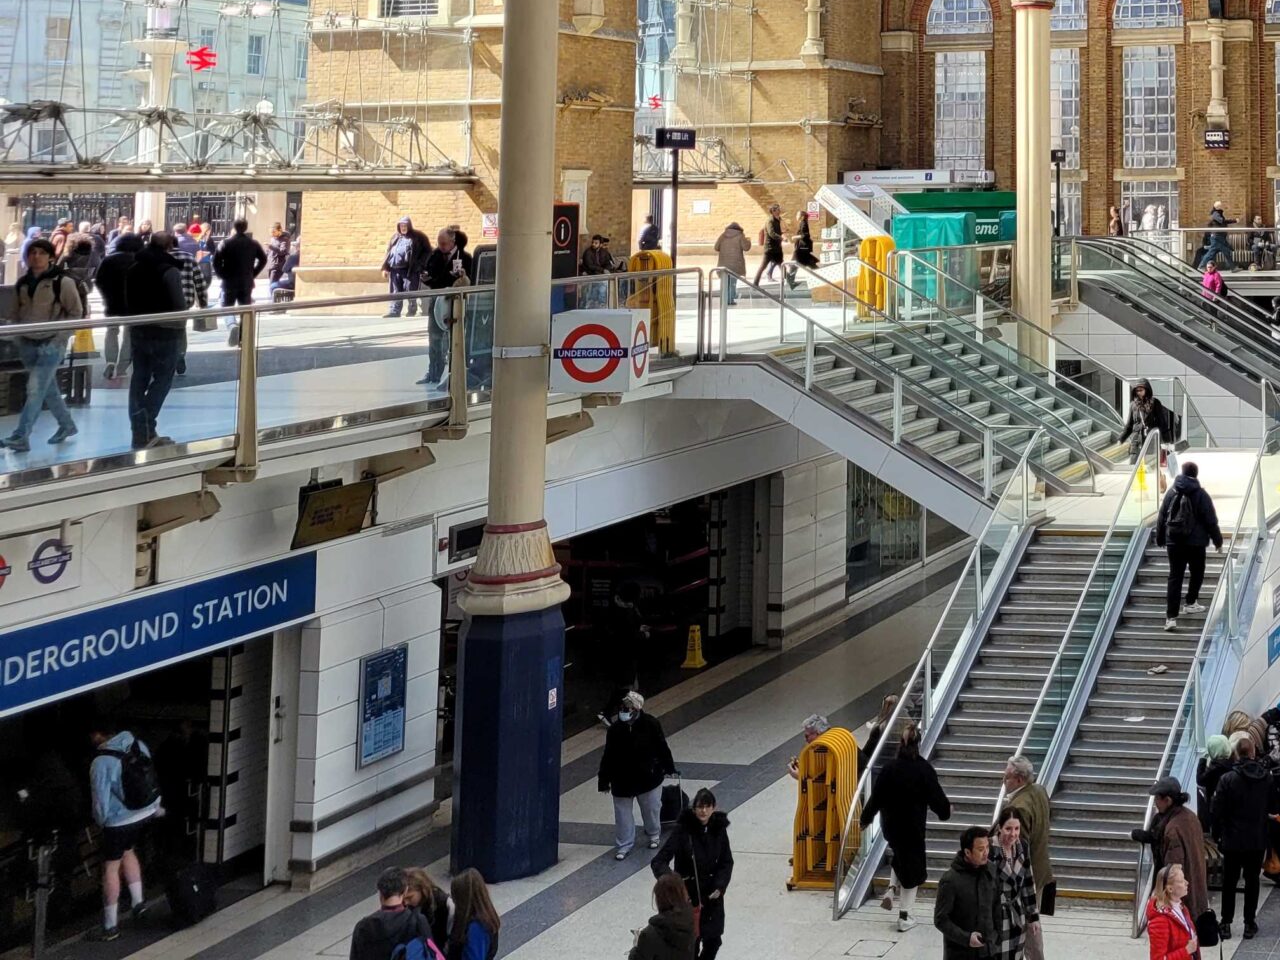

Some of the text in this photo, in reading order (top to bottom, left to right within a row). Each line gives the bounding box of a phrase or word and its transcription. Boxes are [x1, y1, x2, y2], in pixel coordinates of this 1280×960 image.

[557, 349, 624, 358] UNDERGROUND
[0, 578, 289, 688] DERGROUND STATION
